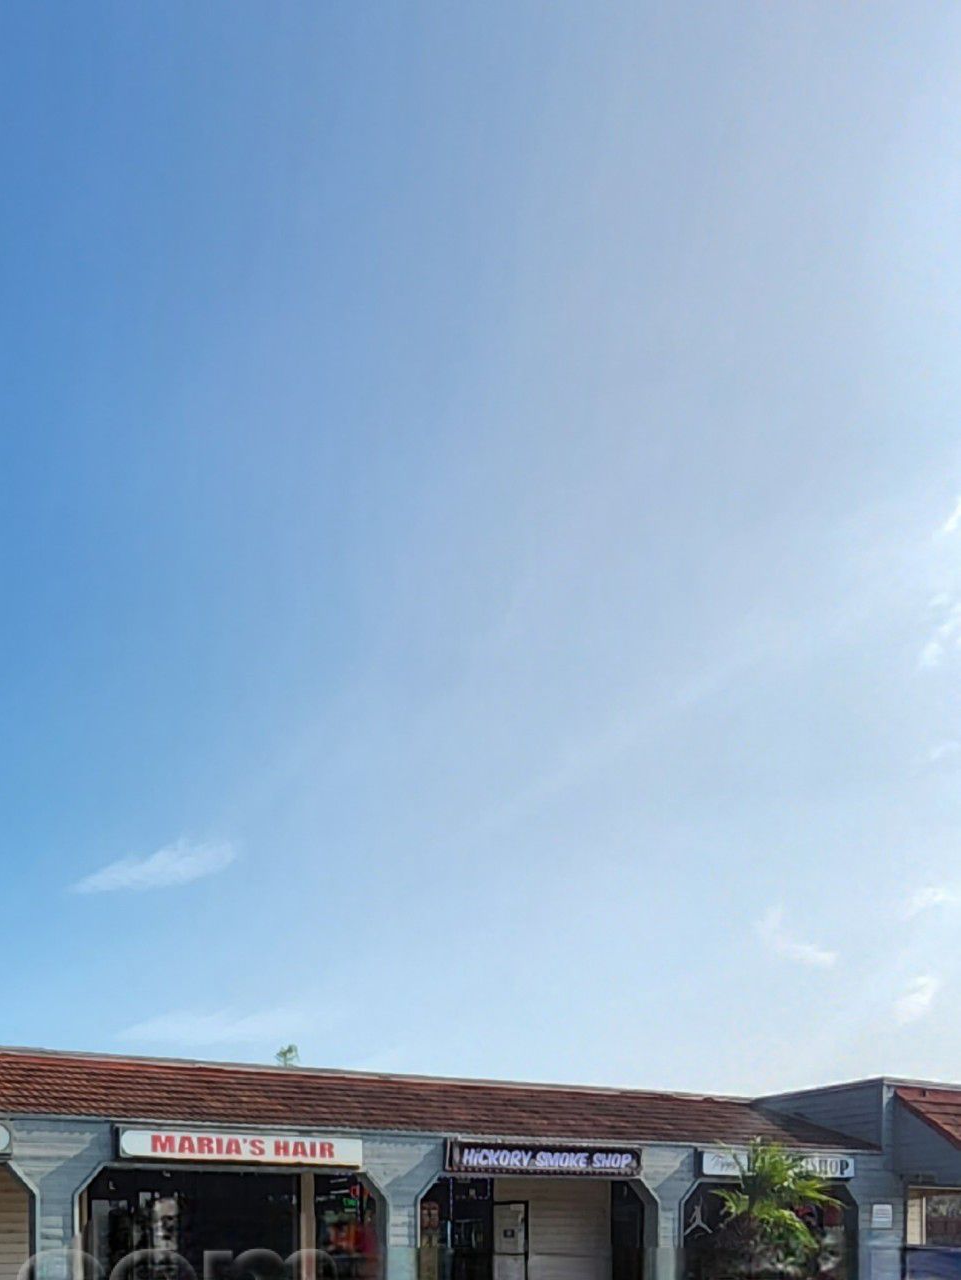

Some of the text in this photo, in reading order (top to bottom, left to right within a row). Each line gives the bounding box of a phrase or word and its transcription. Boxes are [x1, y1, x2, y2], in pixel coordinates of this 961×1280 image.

[151, 1134, 335, 1158] MARIA'S HAIR
[535, 1151, 589, 1167] SMOKE
[592, 1152, 632, 1168] SHOP
